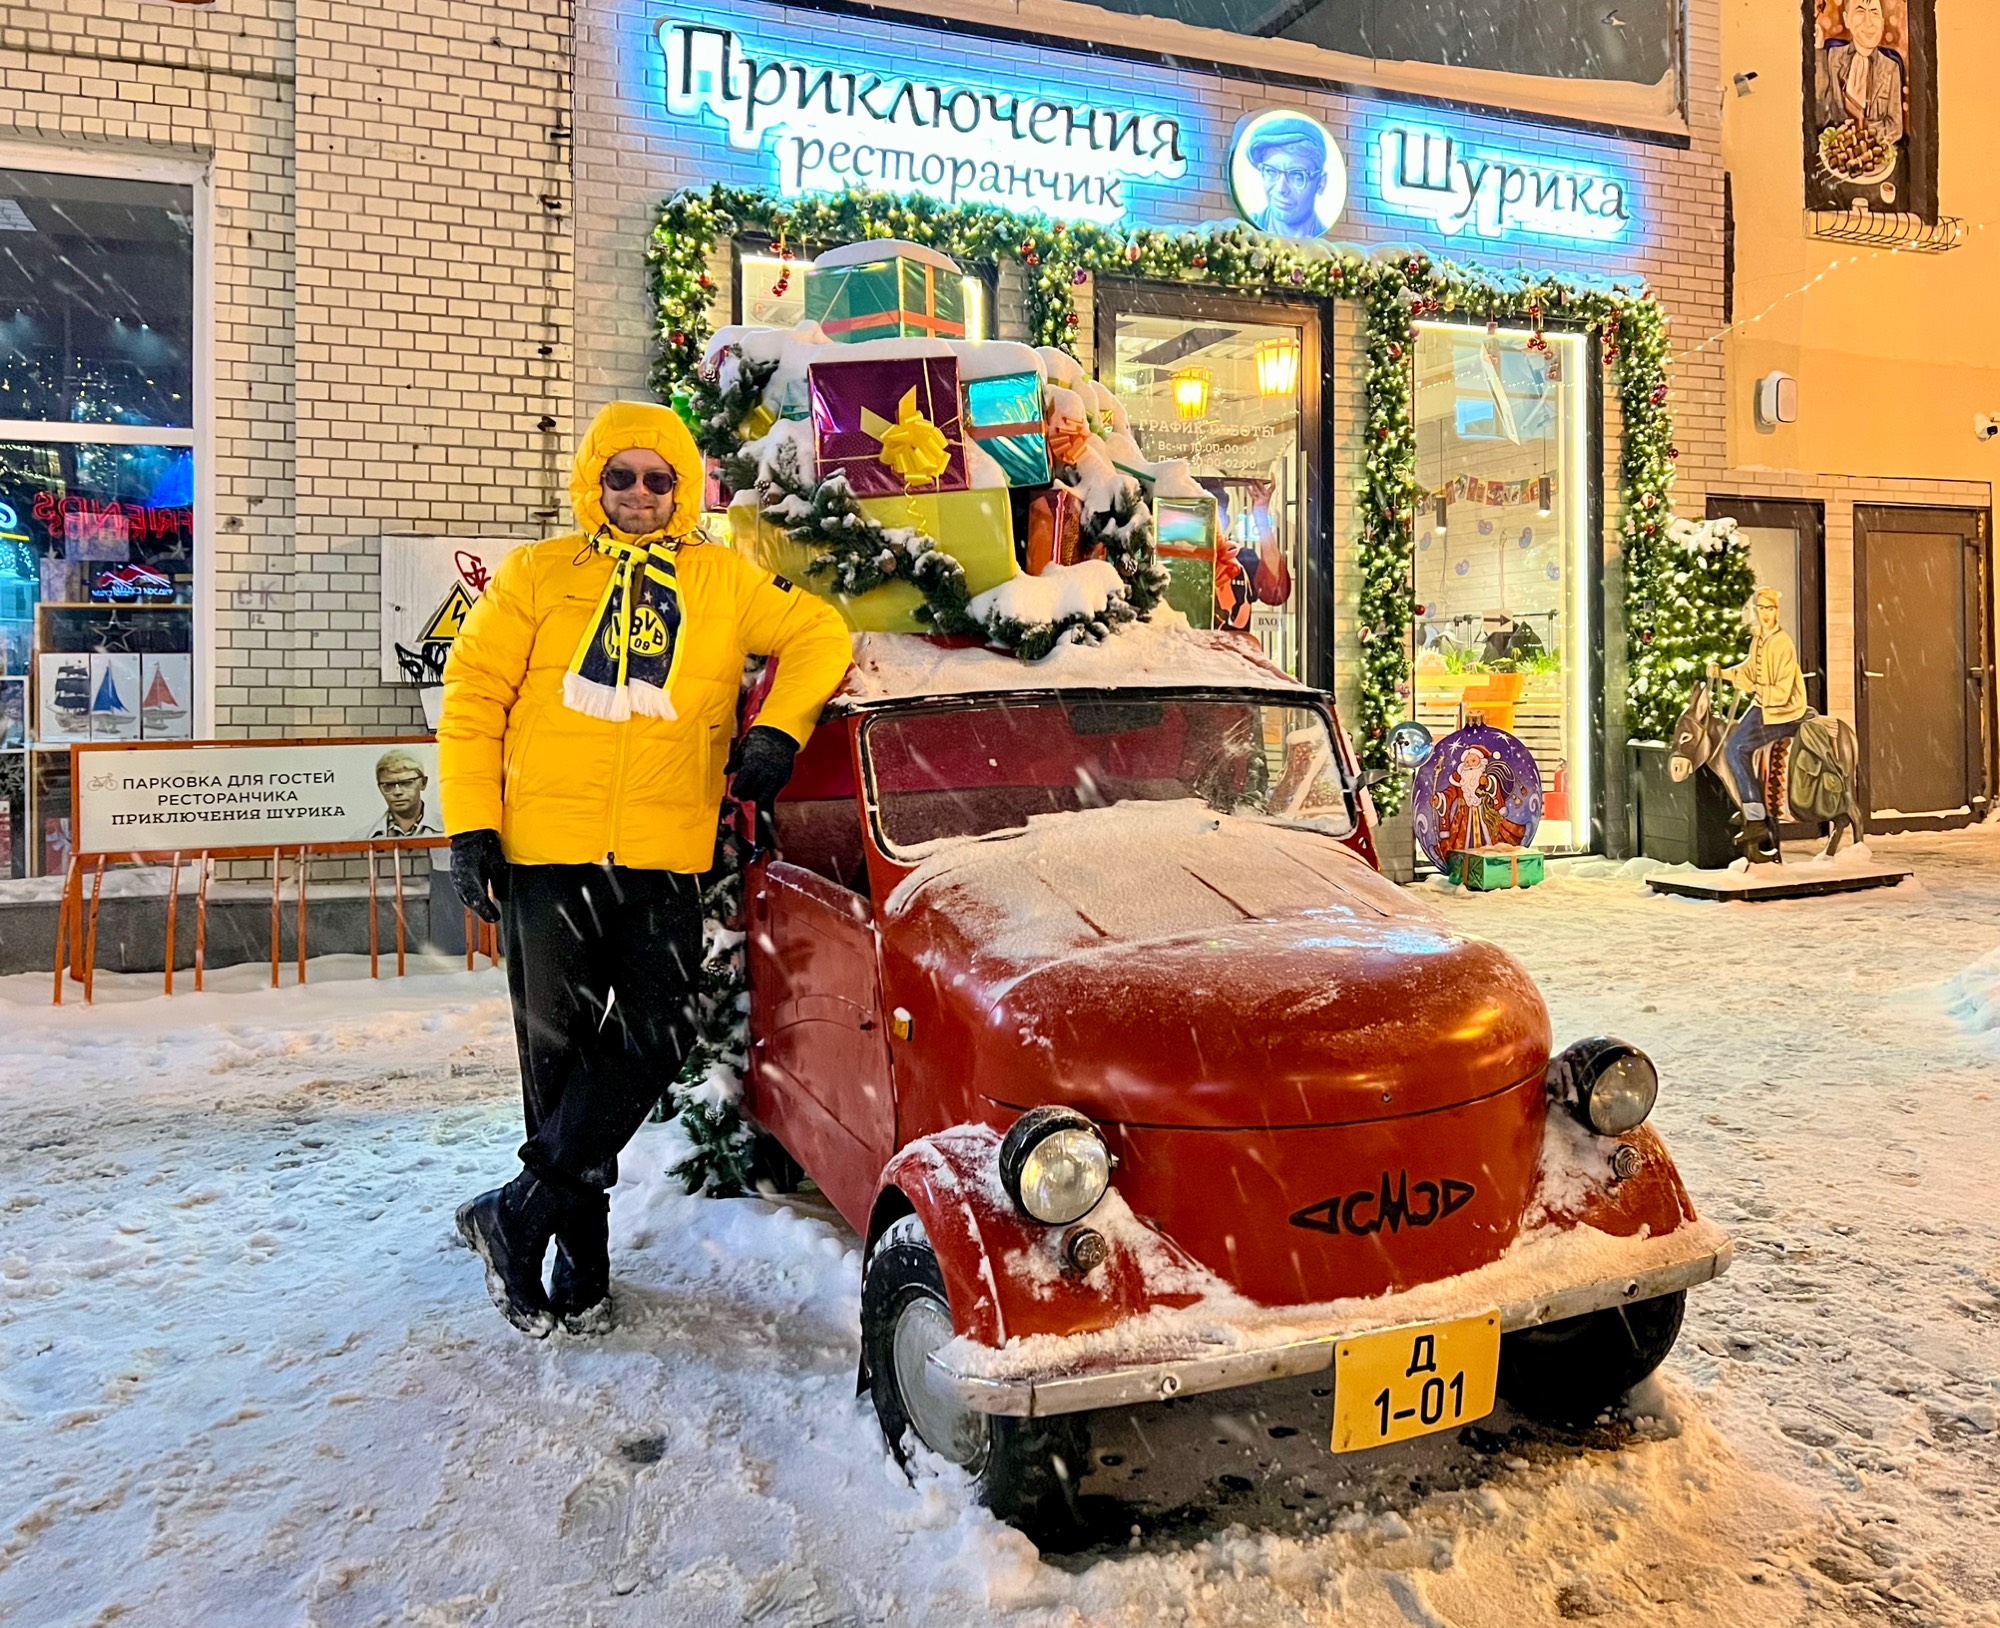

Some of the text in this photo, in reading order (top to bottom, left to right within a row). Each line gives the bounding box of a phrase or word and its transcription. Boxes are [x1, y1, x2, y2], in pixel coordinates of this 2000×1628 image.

[672, 25, 1629, 224] Приключения Шурика
[790, 135, 1123, 208] ресторанчик
[630, 610, 664, 646] BVB
[1258, 617, 1284, 627] ВХО
[634, 637, 651, 651] 09
[122, 770, 335, 790] ПАРКОВКА ДЛЯ ГОСТЕЙ
[158, 790, 299, 806] РЕСТОРАНЧИКА
[111, 806, 346, 826] ПРИКЛЮЧЕНИЯ ШУРИКА
[1405, 1334, 1437, 1378] Д
[1374, 1370, 1465, 1436] 1-01
